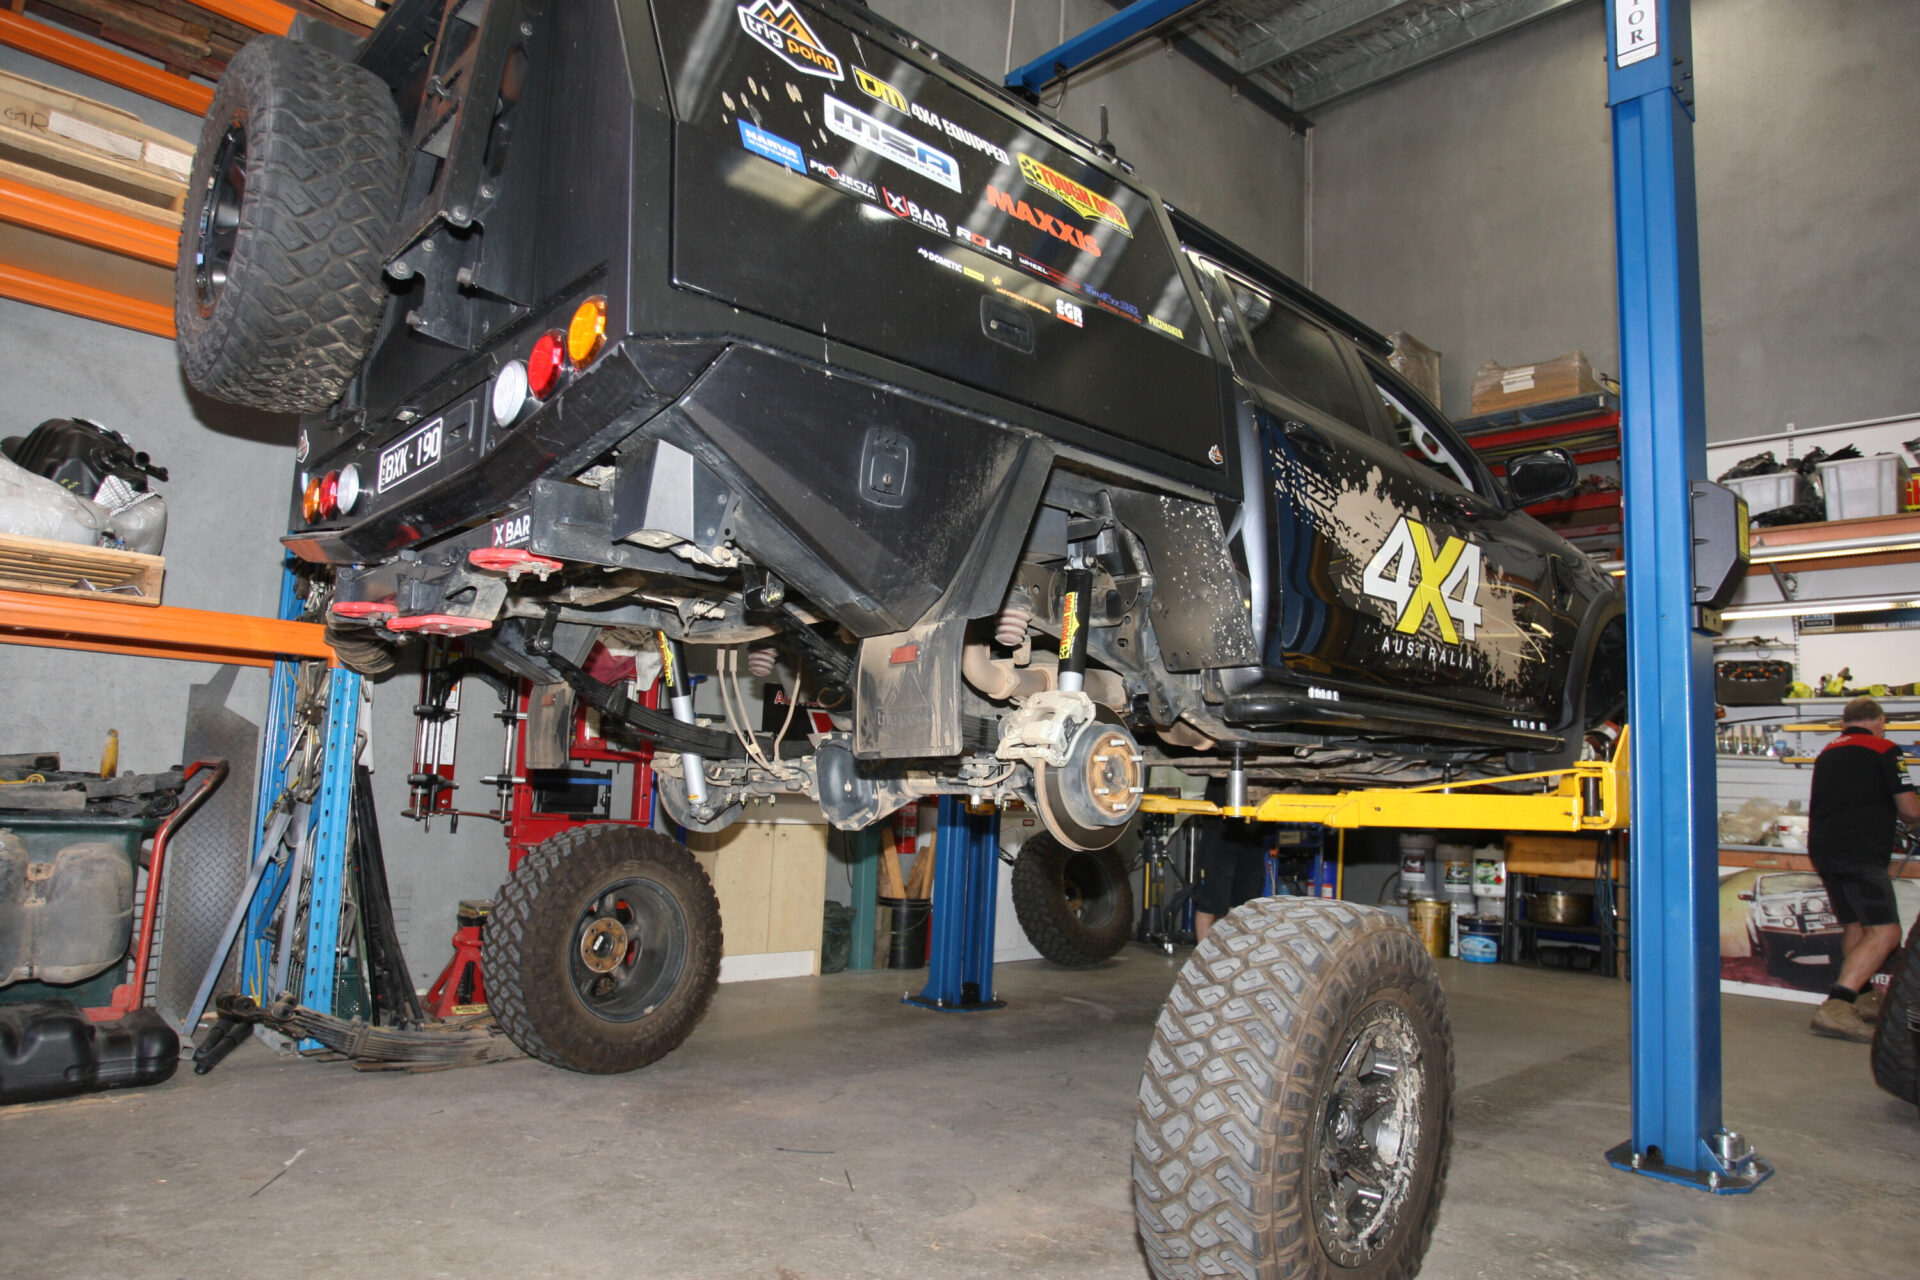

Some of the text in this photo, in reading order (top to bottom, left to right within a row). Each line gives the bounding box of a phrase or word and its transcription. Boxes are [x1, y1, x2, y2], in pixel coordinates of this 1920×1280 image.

[746, 15, 837, 73] trig point
[745, 129, 798, 159] NARVA
[941, 118, 1010, 166] EQUIPPED
[810, 159, 877, 196] PROJECTA
[1037, 164, 1093, 208] TOUGH
[1090, 194, 1126, 226] DOG
[986, 184, 1102, 257] MAXXIS
[956, 225, 1013, 260] ROLA
[928, 251, 963, 273] DOMETIC
[1056, 298, 1083, 323] EGR
[1363, 515, 1483, 645] 4X4
[1382, 636, 1474, 670] AUSTRALIA
